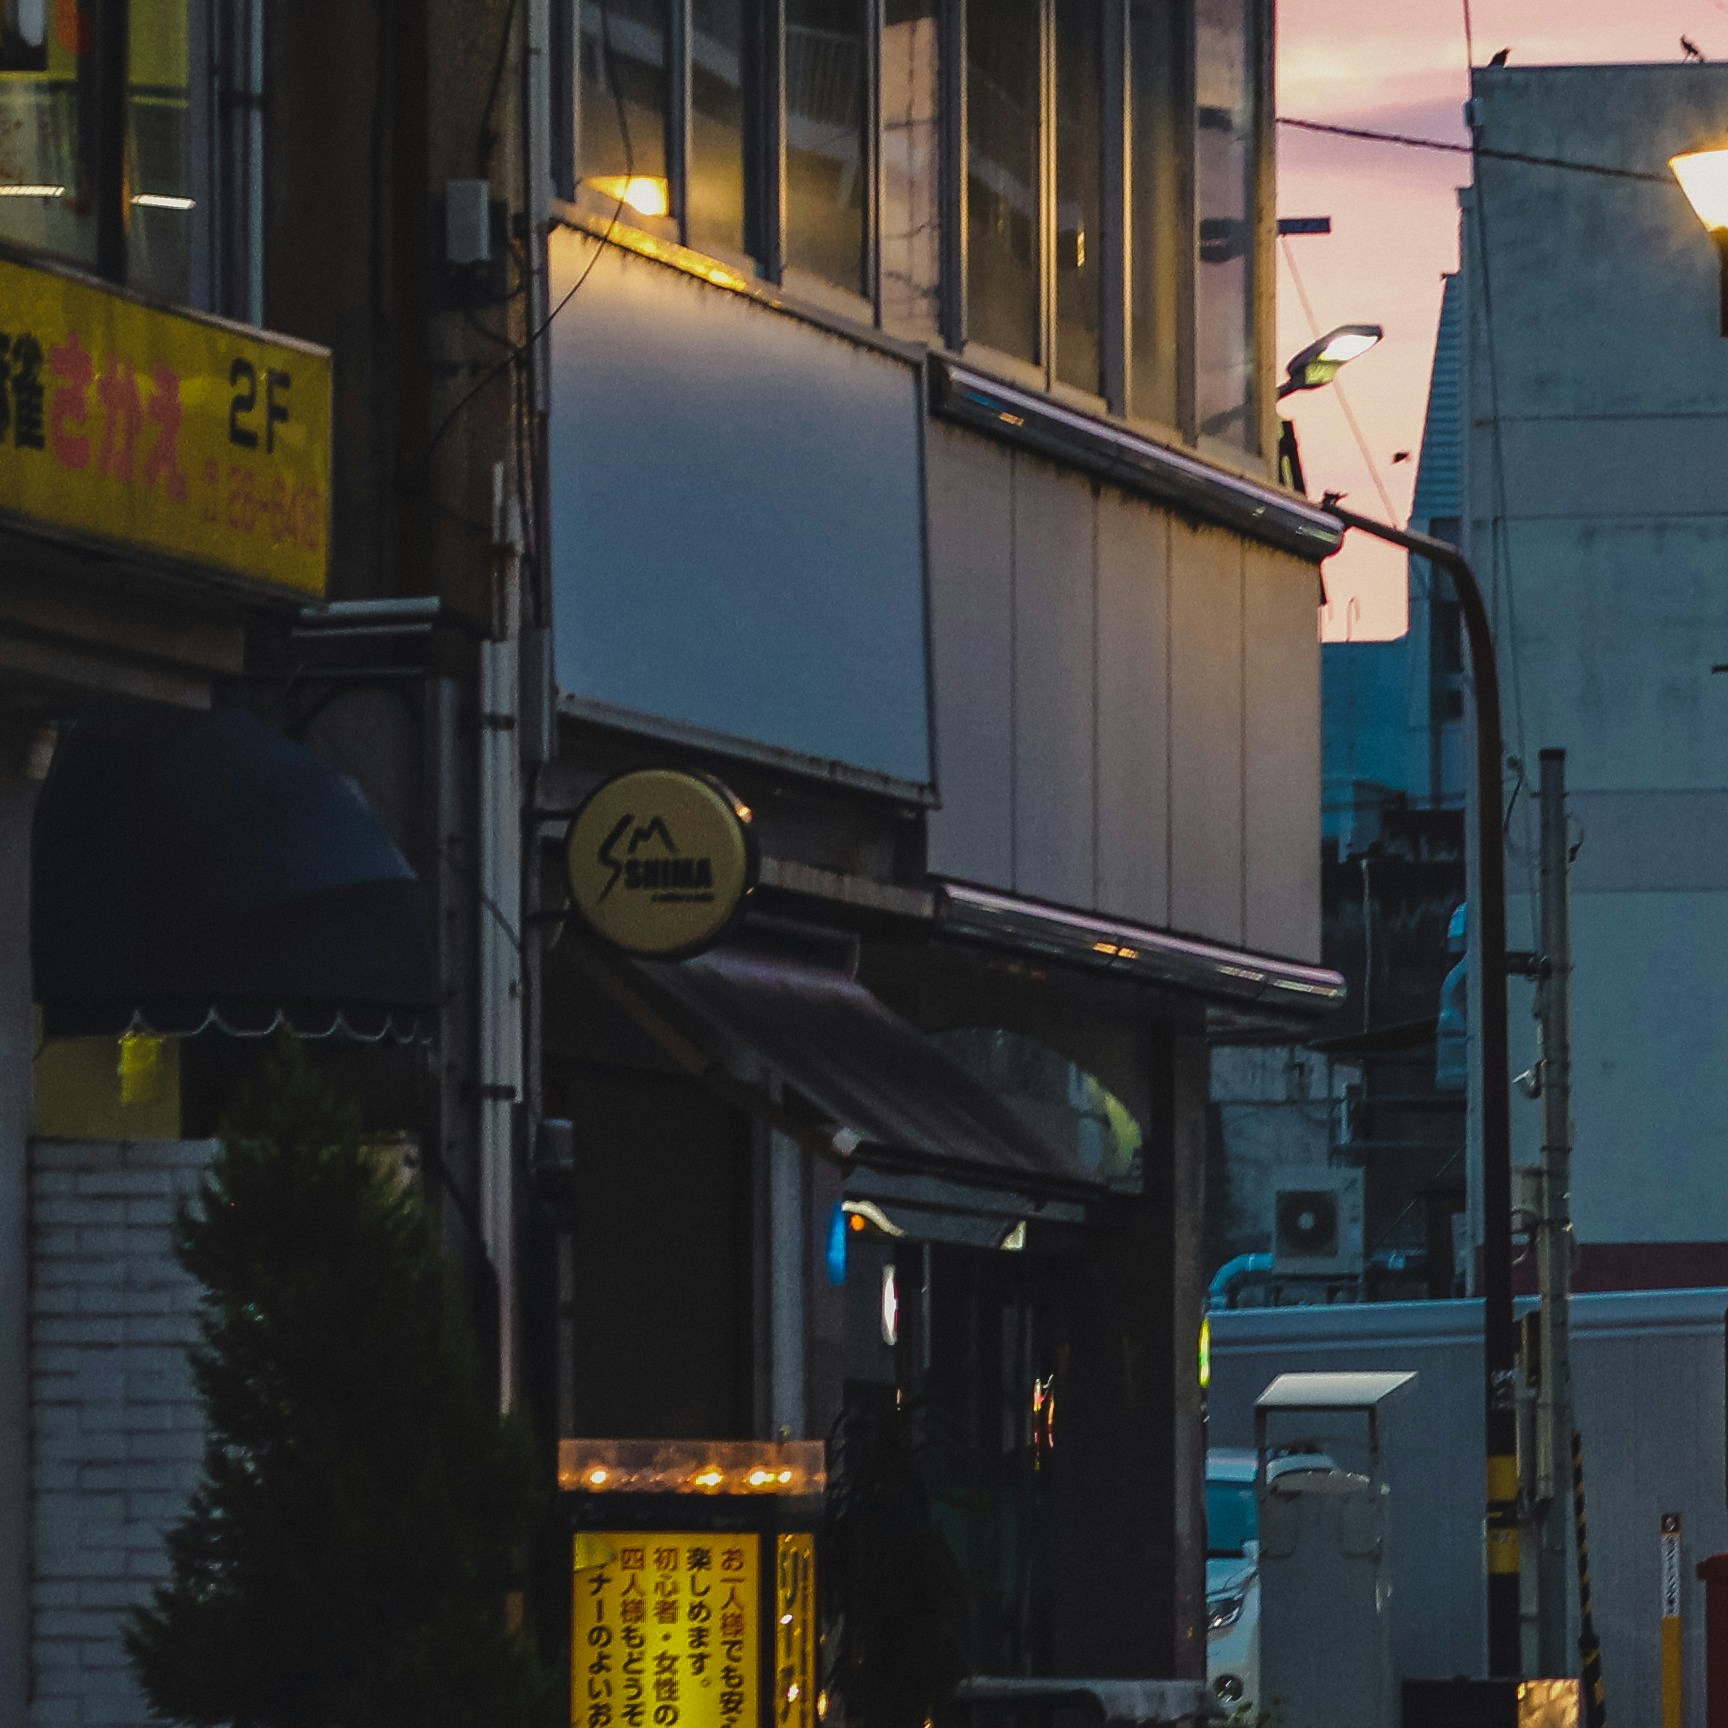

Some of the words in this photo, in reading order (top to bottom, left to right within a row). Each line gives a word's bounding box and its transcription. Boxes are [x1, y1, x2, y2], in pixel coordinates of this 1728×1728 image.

[229, 357, 291, 454] 2F
[687, 1546, 712, 1688] 楽しめます。
